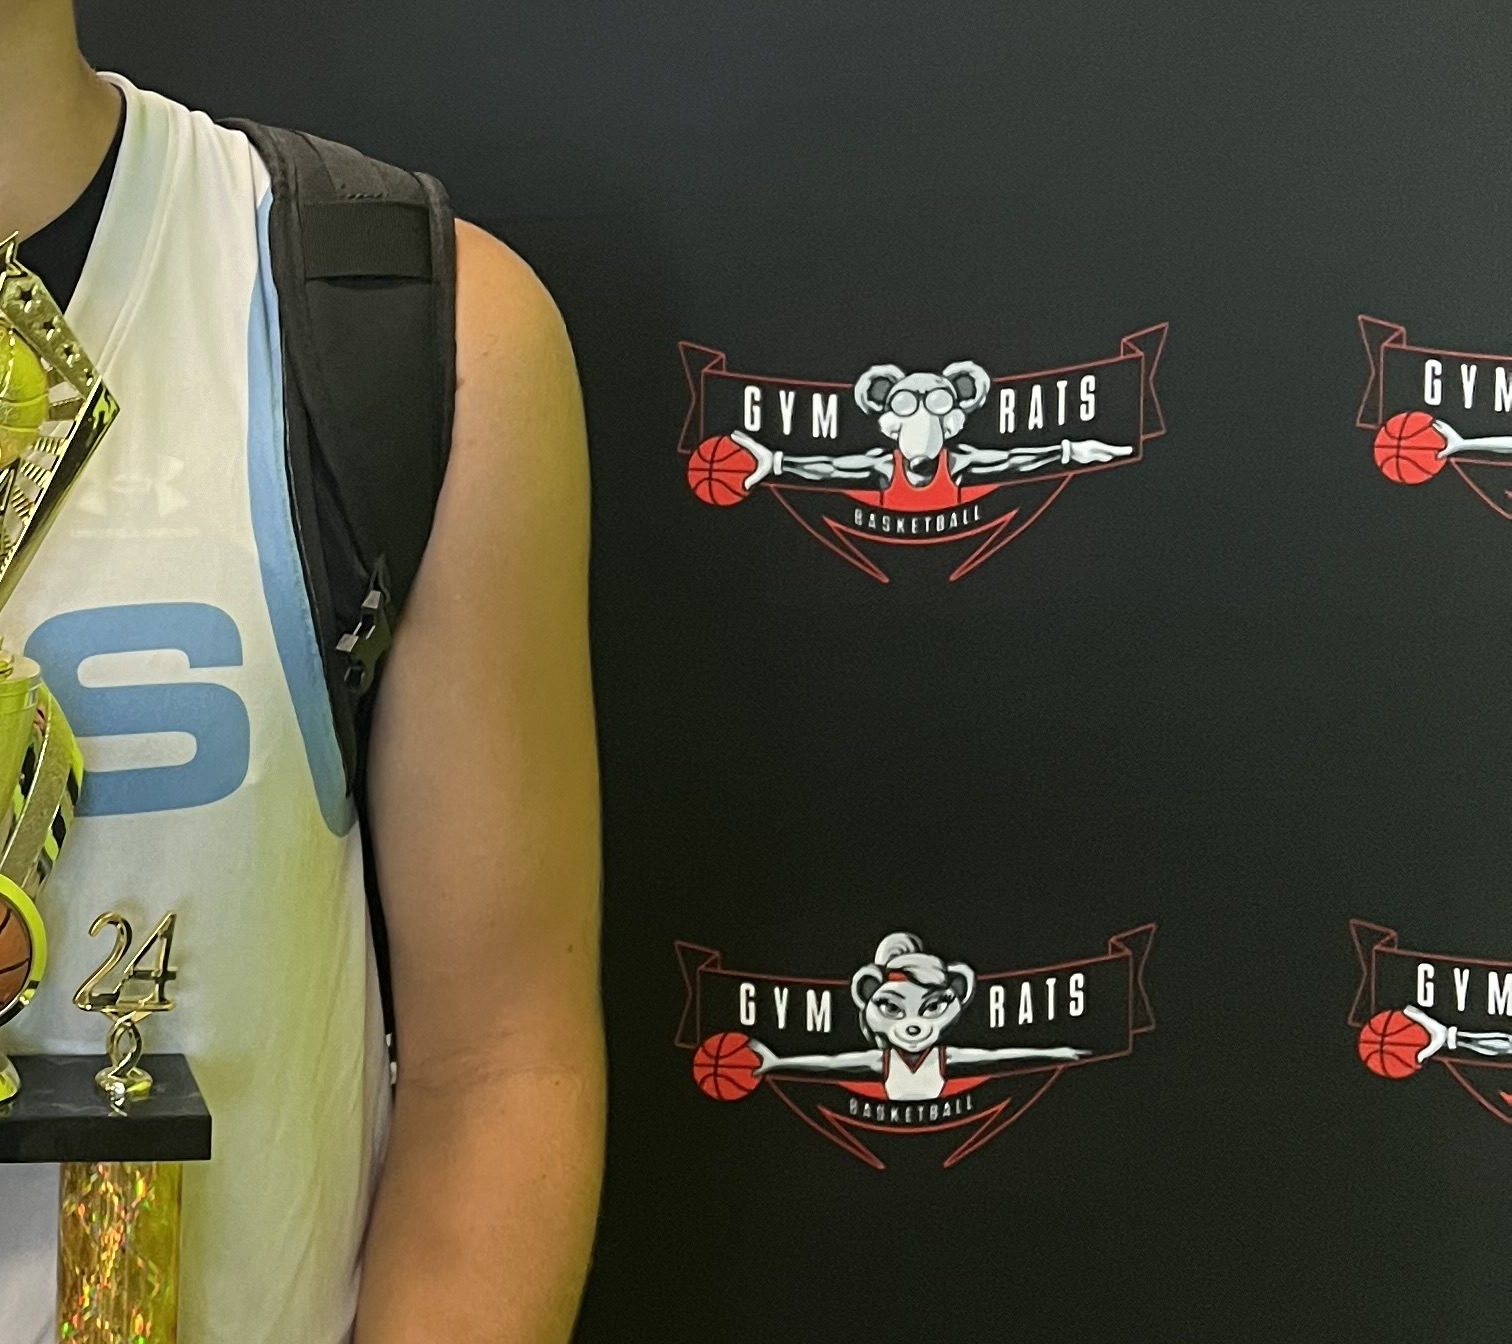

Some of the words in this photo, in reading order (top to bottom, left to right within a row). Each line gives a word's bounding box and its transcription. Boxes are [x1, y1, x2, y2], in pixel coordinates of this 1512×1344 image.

[745, 386, 837, 439] GYM
[1000, 375, 1095, 433] RATS
[854, 506, 981, 537] BASKETBALL
[72, 912, 178, 1009] 24
[740, 983, 830, 1032] GYM
[990, 973, 1084, 1028] RATS
[1417, 963, 1512, 1016] GYM
[850, 1096, 971, 1122] BASKETBALL
